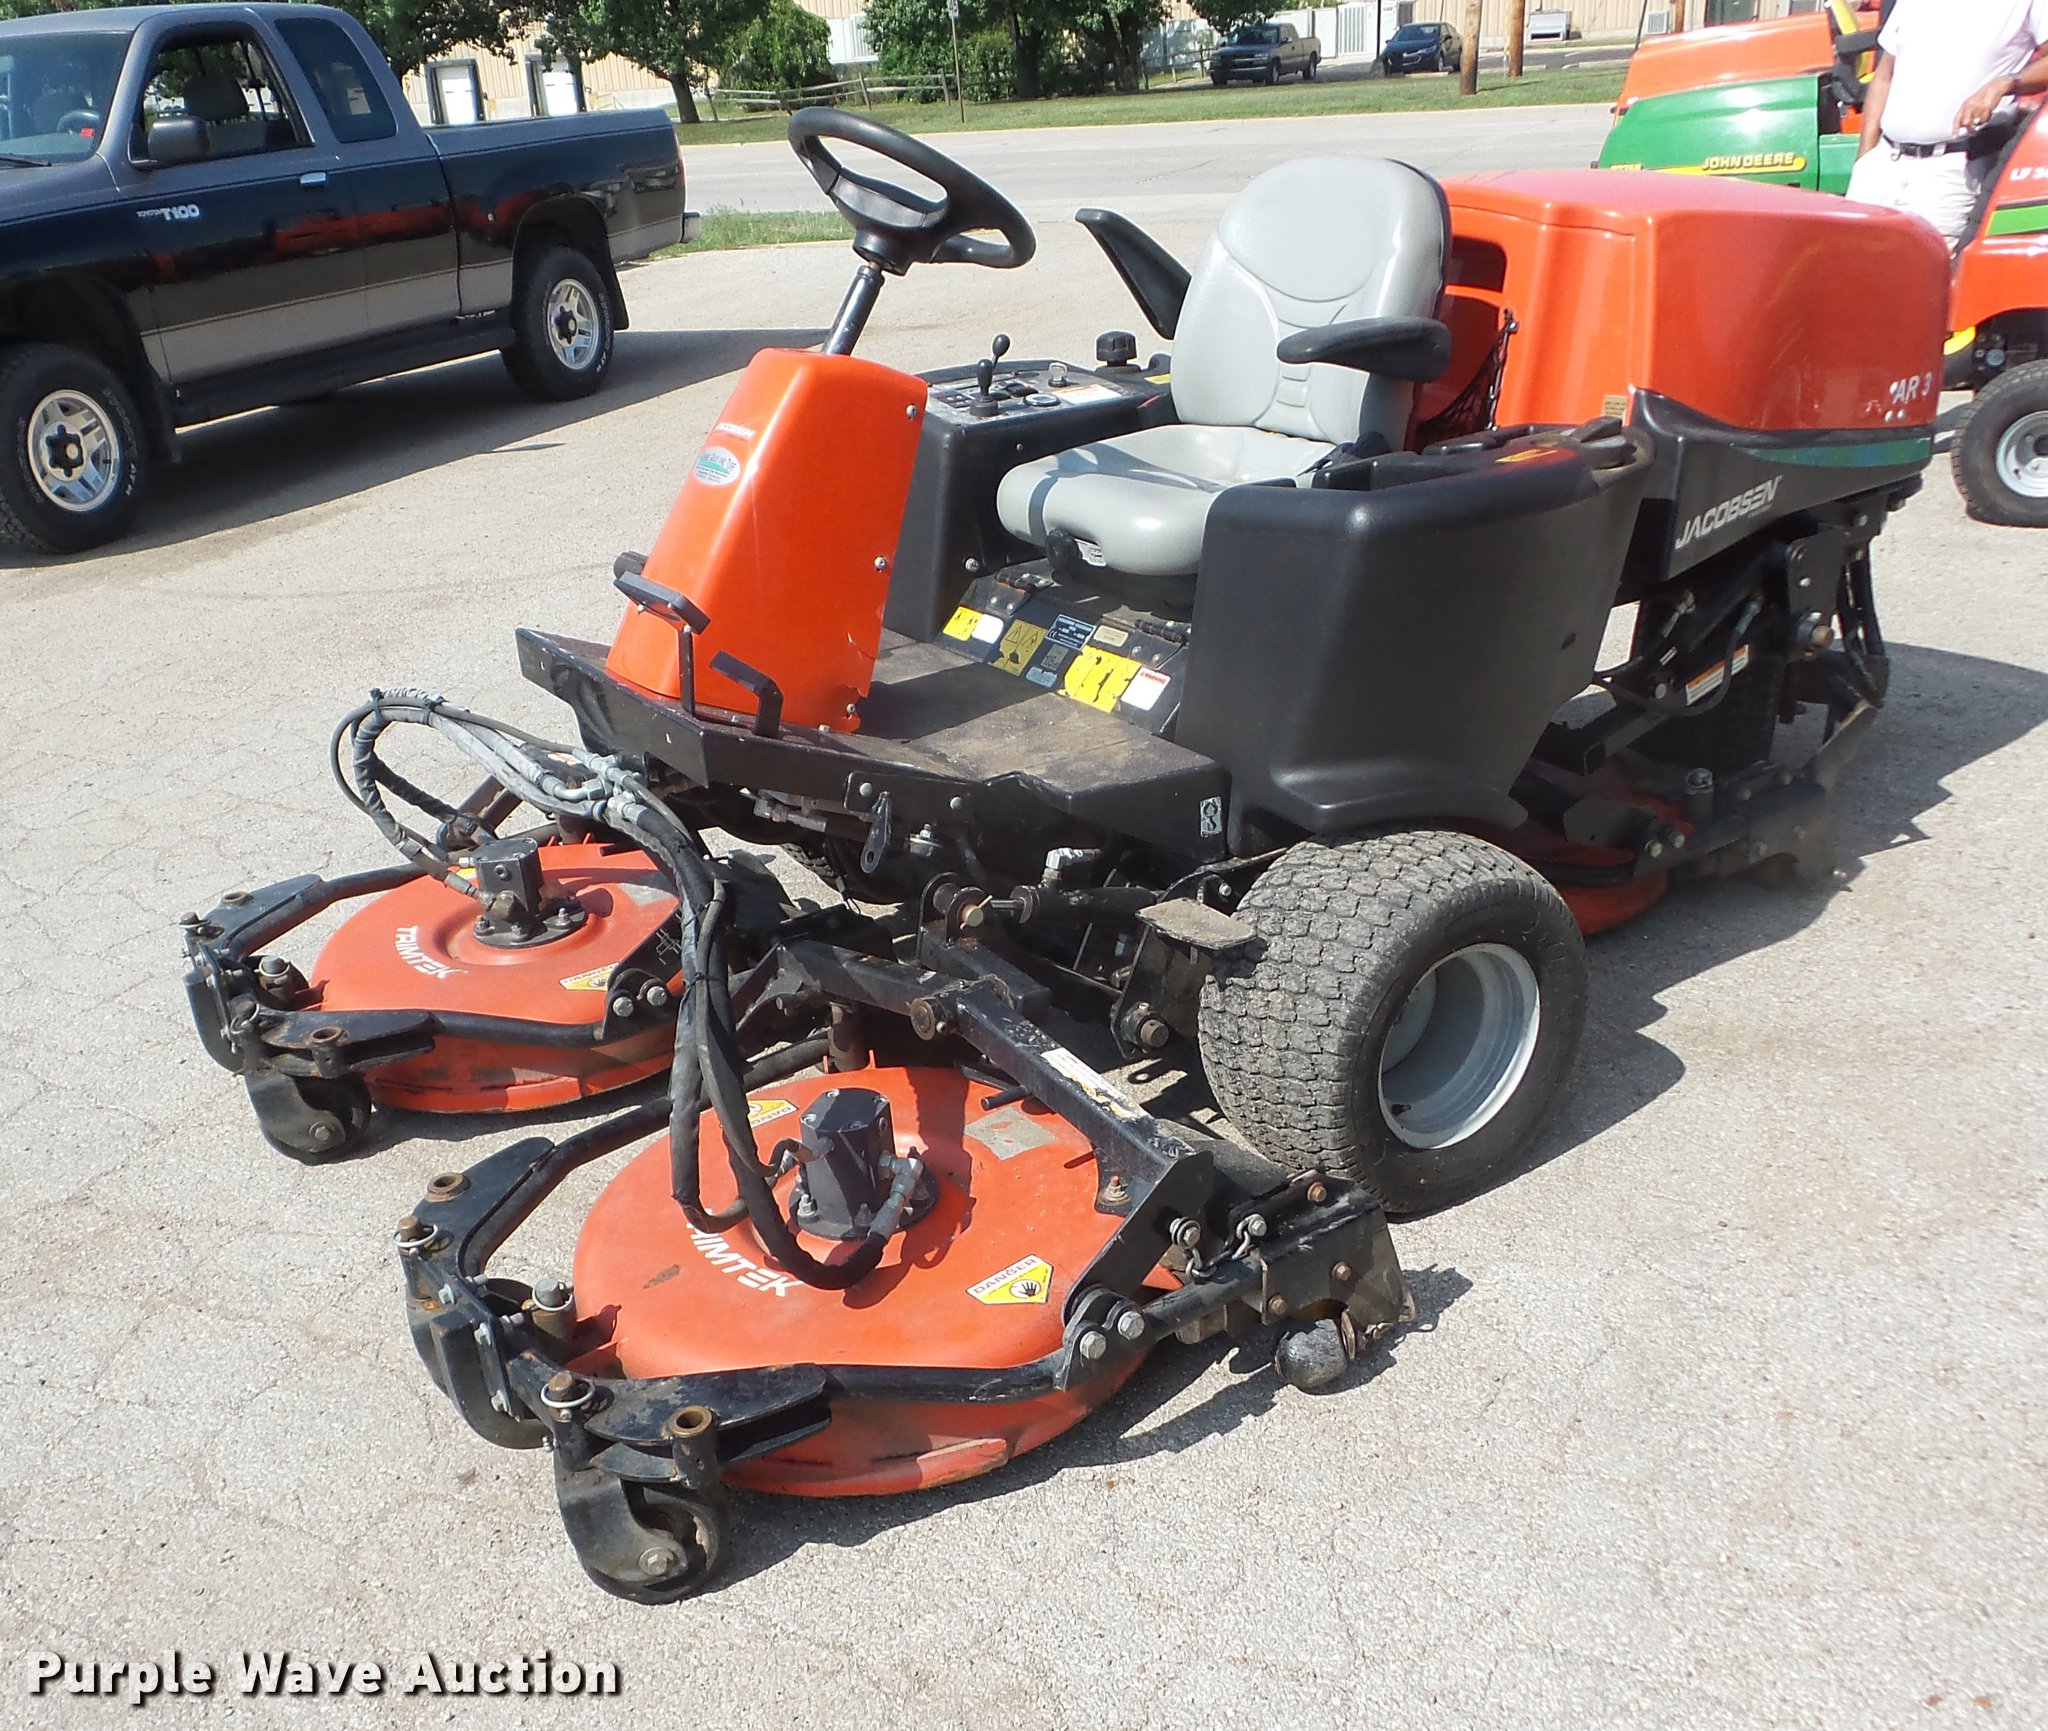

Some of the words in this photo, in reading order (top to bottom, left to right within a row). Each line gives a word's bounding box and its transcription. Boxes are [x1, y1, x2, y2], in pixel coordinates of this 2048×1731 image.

[1699, 155, 1742, 171] JOHN
[1743, 151, 1796, 168] DEERE
[2009, 166, 2032, 182] LF
[160, 203, 200, 220] T100
[1891, 375, 1920, 404] AR
[1674, 475, 1782, 549] JACOBSEN
[394, 924, 463, 980] TRIMTEK
[974, 1258, 1037, 1294] DANGER
